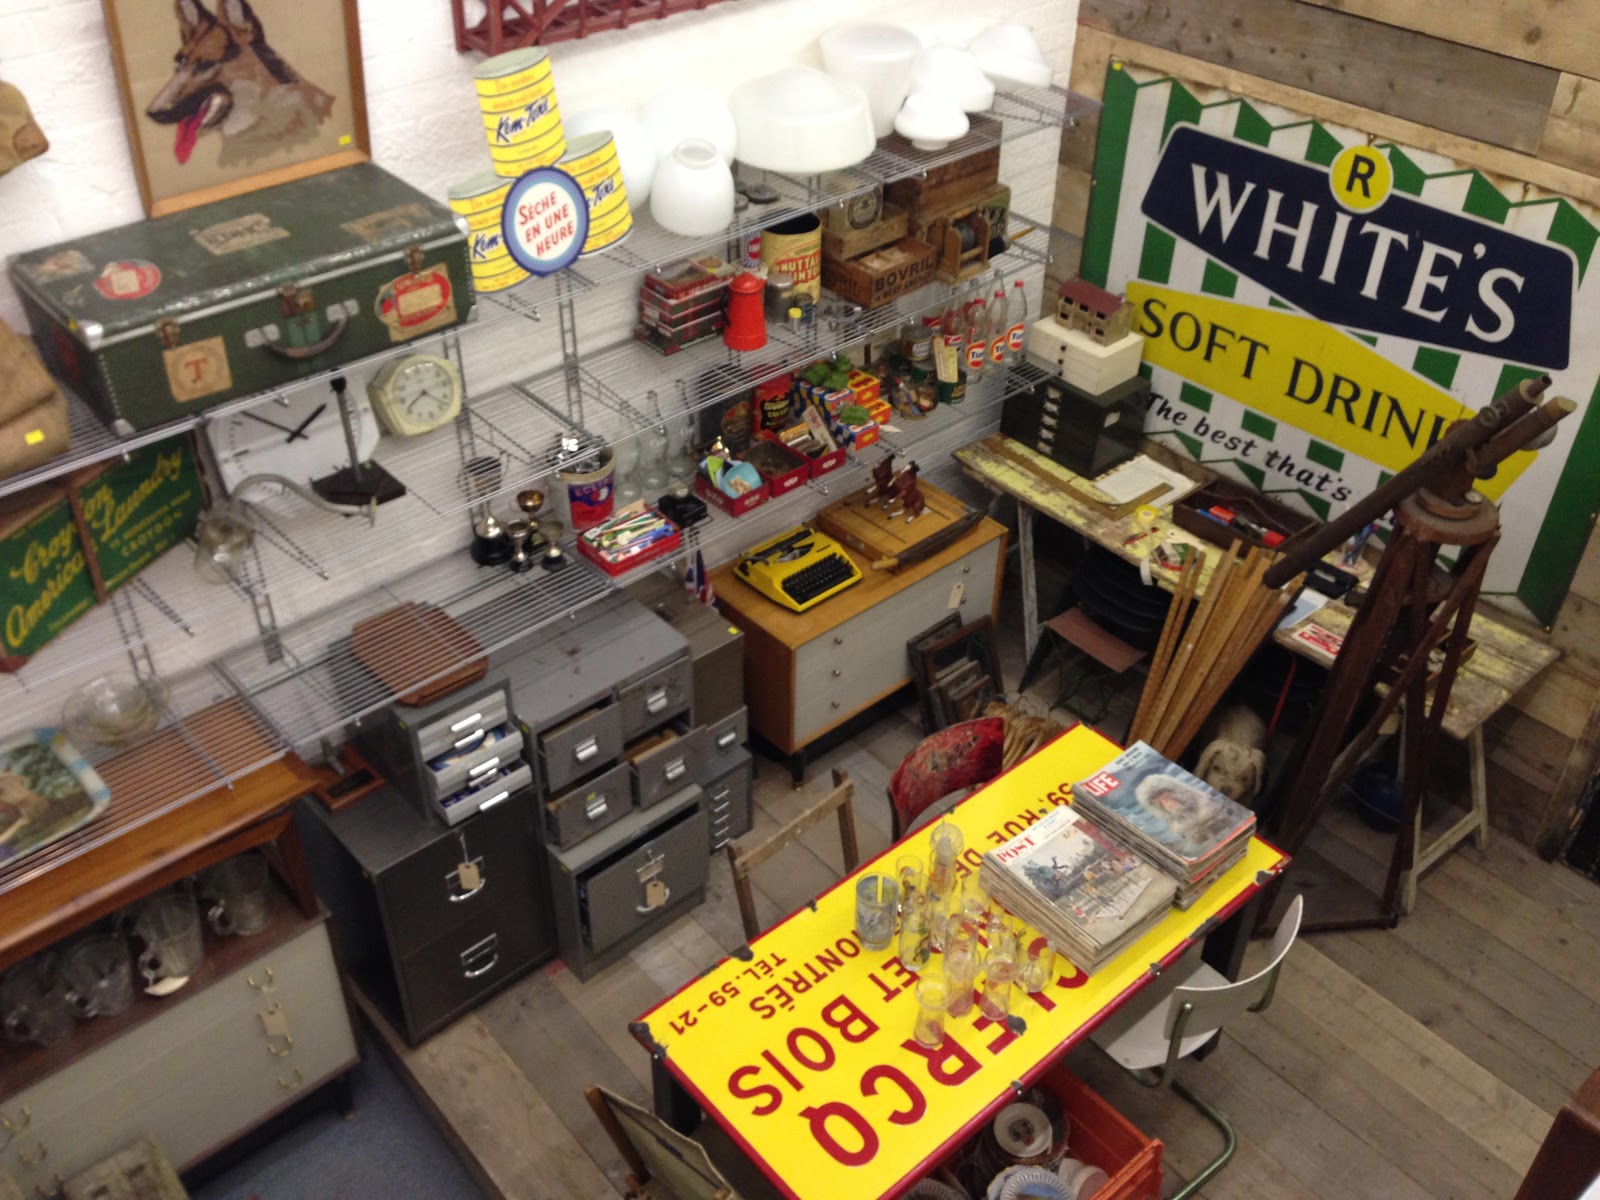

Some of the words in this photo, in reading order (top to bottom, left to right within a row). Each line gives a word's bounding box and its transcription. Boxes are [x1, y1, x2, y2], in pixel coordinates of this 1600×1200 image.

[1346, 154, 1376, 199] R
[525, 223, 541, 243] EN
[545, 203, 570, 229] UNE
[536, 223, 574, 256] HEURE
[874, 257, 934, 293] BOVRIL
[1191, 164, 1525, 343] WHITE'S
[1140, 297, 1269, 379] SOFT
[1146, 392, 1187, 426] The
[1194, 416, 1258, 457] best
[1266, 448, 1353, 501] that's
[1085, 772, 1119, 796] LIFE
[998, 836, 1036, 863] POST
[868, 956, 921, 1003] ET
[727, 994, 880, 1117] BOIS
